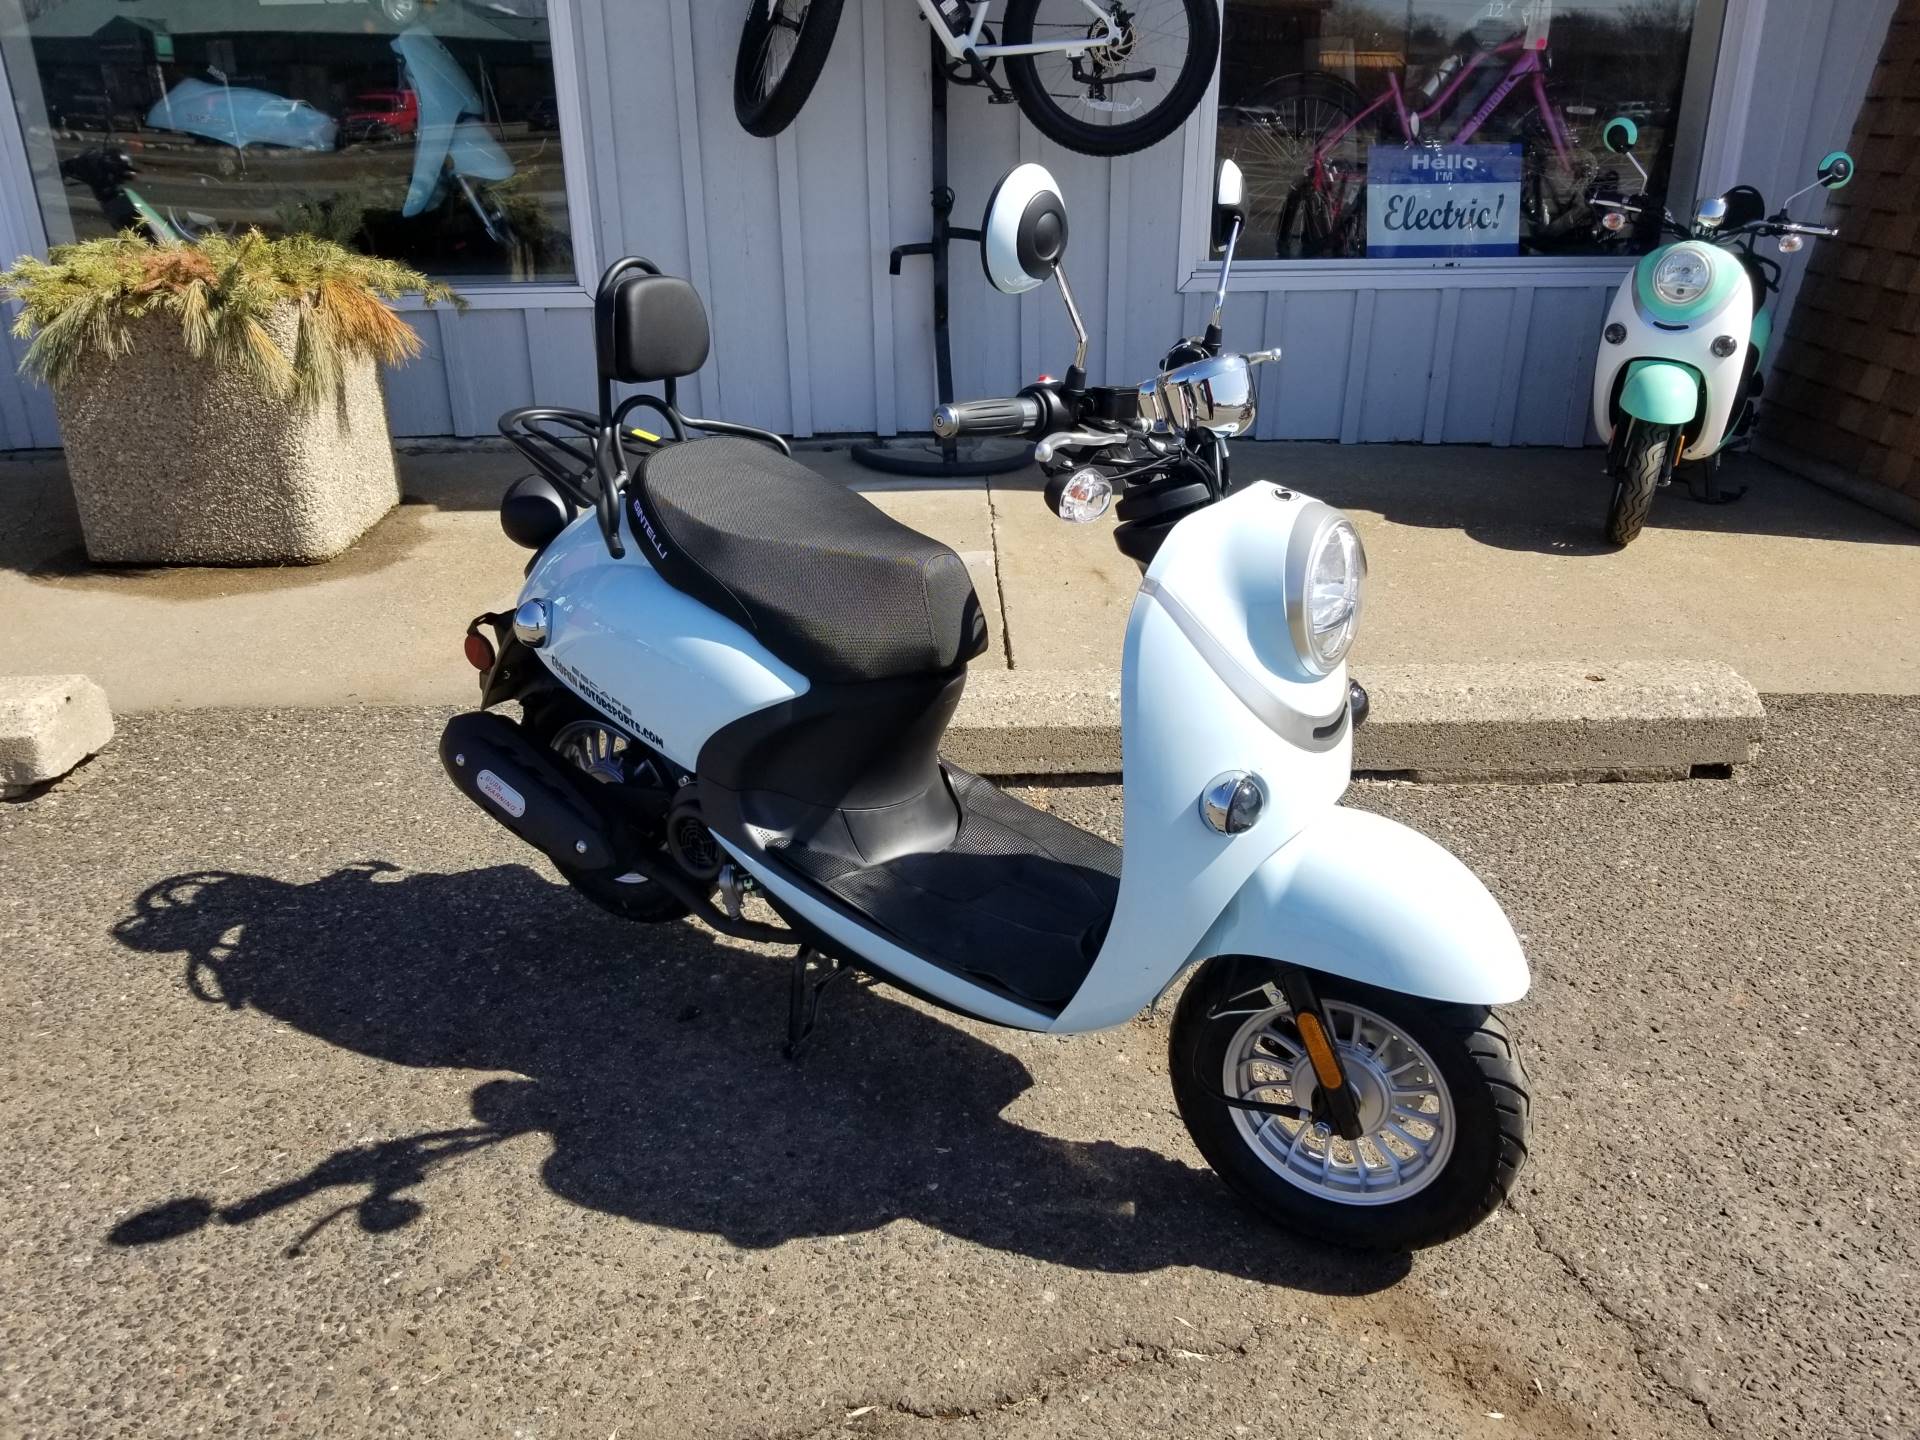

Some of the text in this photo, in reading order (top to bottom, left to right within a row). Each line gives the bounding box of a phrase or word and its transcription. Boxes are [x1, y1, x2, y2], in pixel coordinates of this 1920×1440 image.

[1411, 154, 1478, 171] Hello
[1435, 172, 1453, 182] I'M
[1384, 193, 1505, 231] Electric!
[633, 499, 668, 559] BINTELLI
[578, 682, 664, 749] MOTORSPORTS.COM
[484, 784, 518, 812] WARNING
